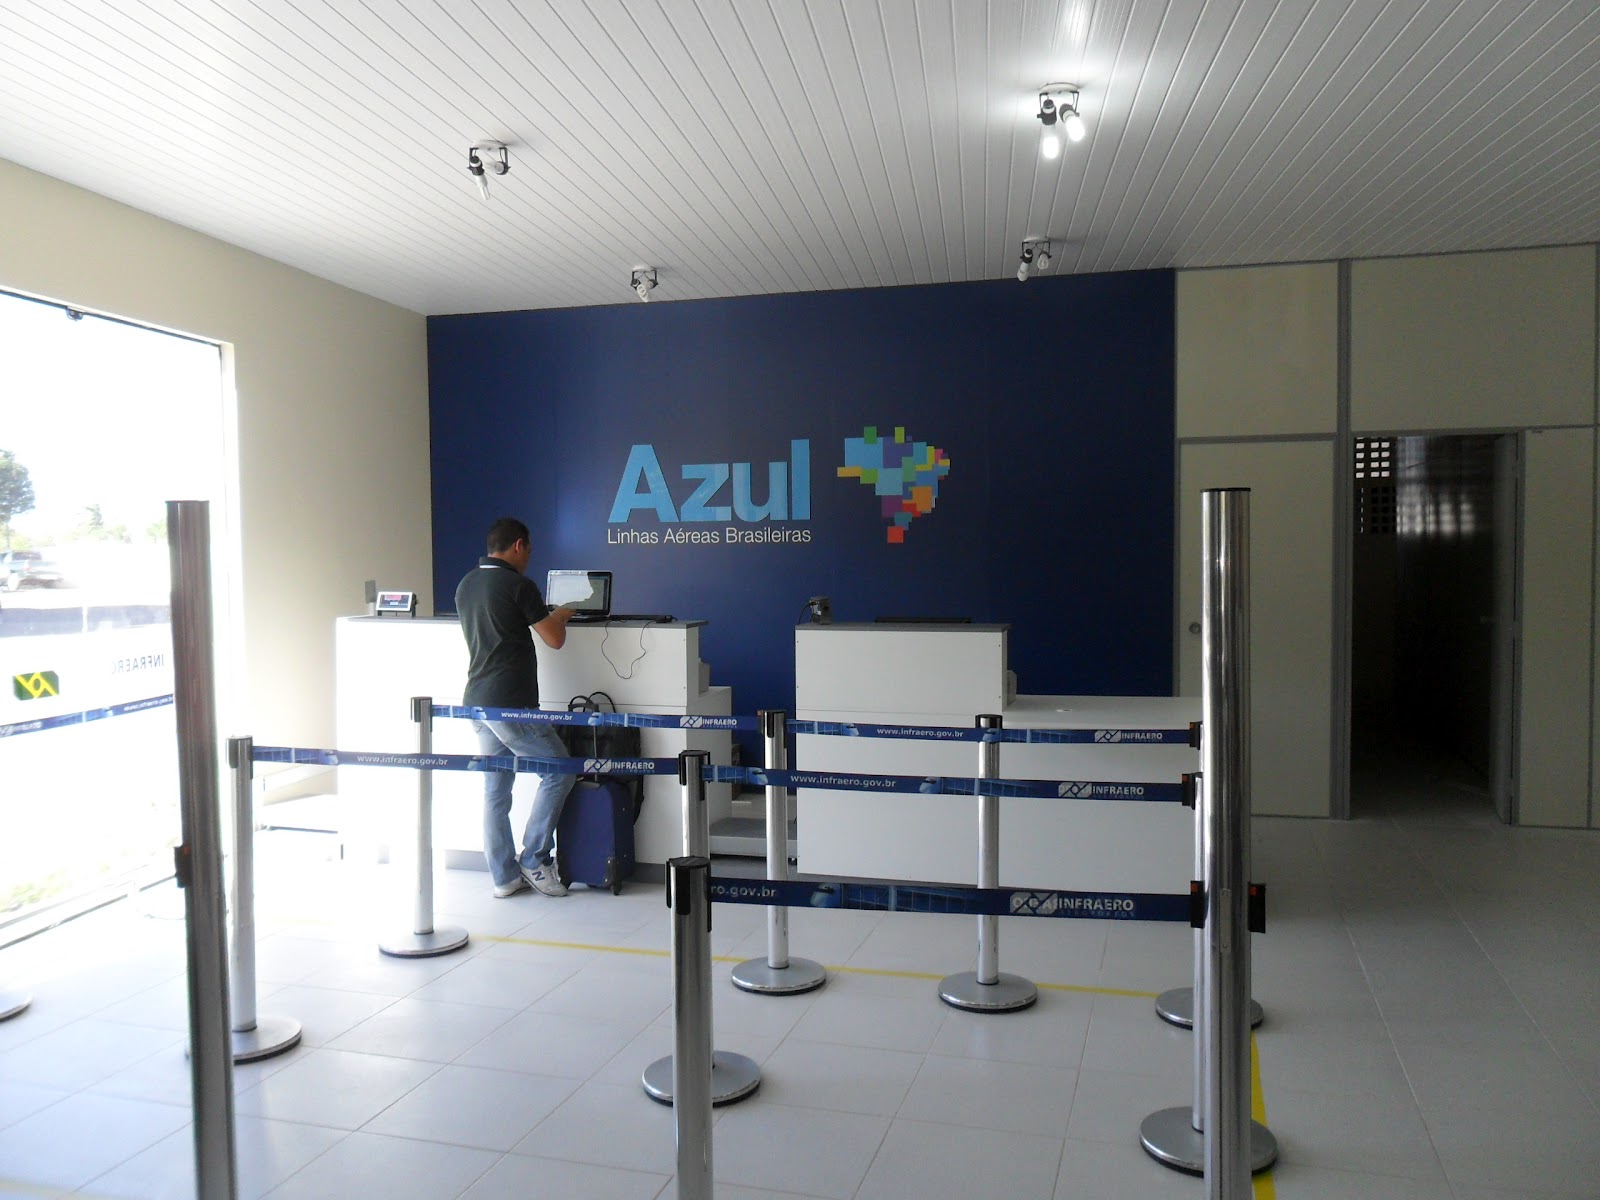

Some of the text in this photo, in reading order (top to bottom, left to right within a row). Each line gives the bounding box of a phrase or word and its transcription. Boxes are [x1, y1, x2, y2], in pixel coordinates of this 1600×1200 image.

[607, 438, 810, 523] Azul
[607, 526, 812, 544] Linhas Aéreas Brasileiras
[501, 711, 573, 721] www.infraero.gov.br
[702, 718, 738, 726] INFRAERO
[877, 727, 964, 738] www.infraero.gov.br
[1121, 732, 1163, 740] INFRAERO
[357, 755, 449, 766] www.infraero.gov.br
[611, 761, 655, 770] INFRAERO
[790, 774, 896, 788] www.infraero.gov.br
[1092, 785, 1145, 795] INFRAERO
[711, 885, 776, 898] ro.gov.br
[1058, 897, 1134, 911] INFRAERO
